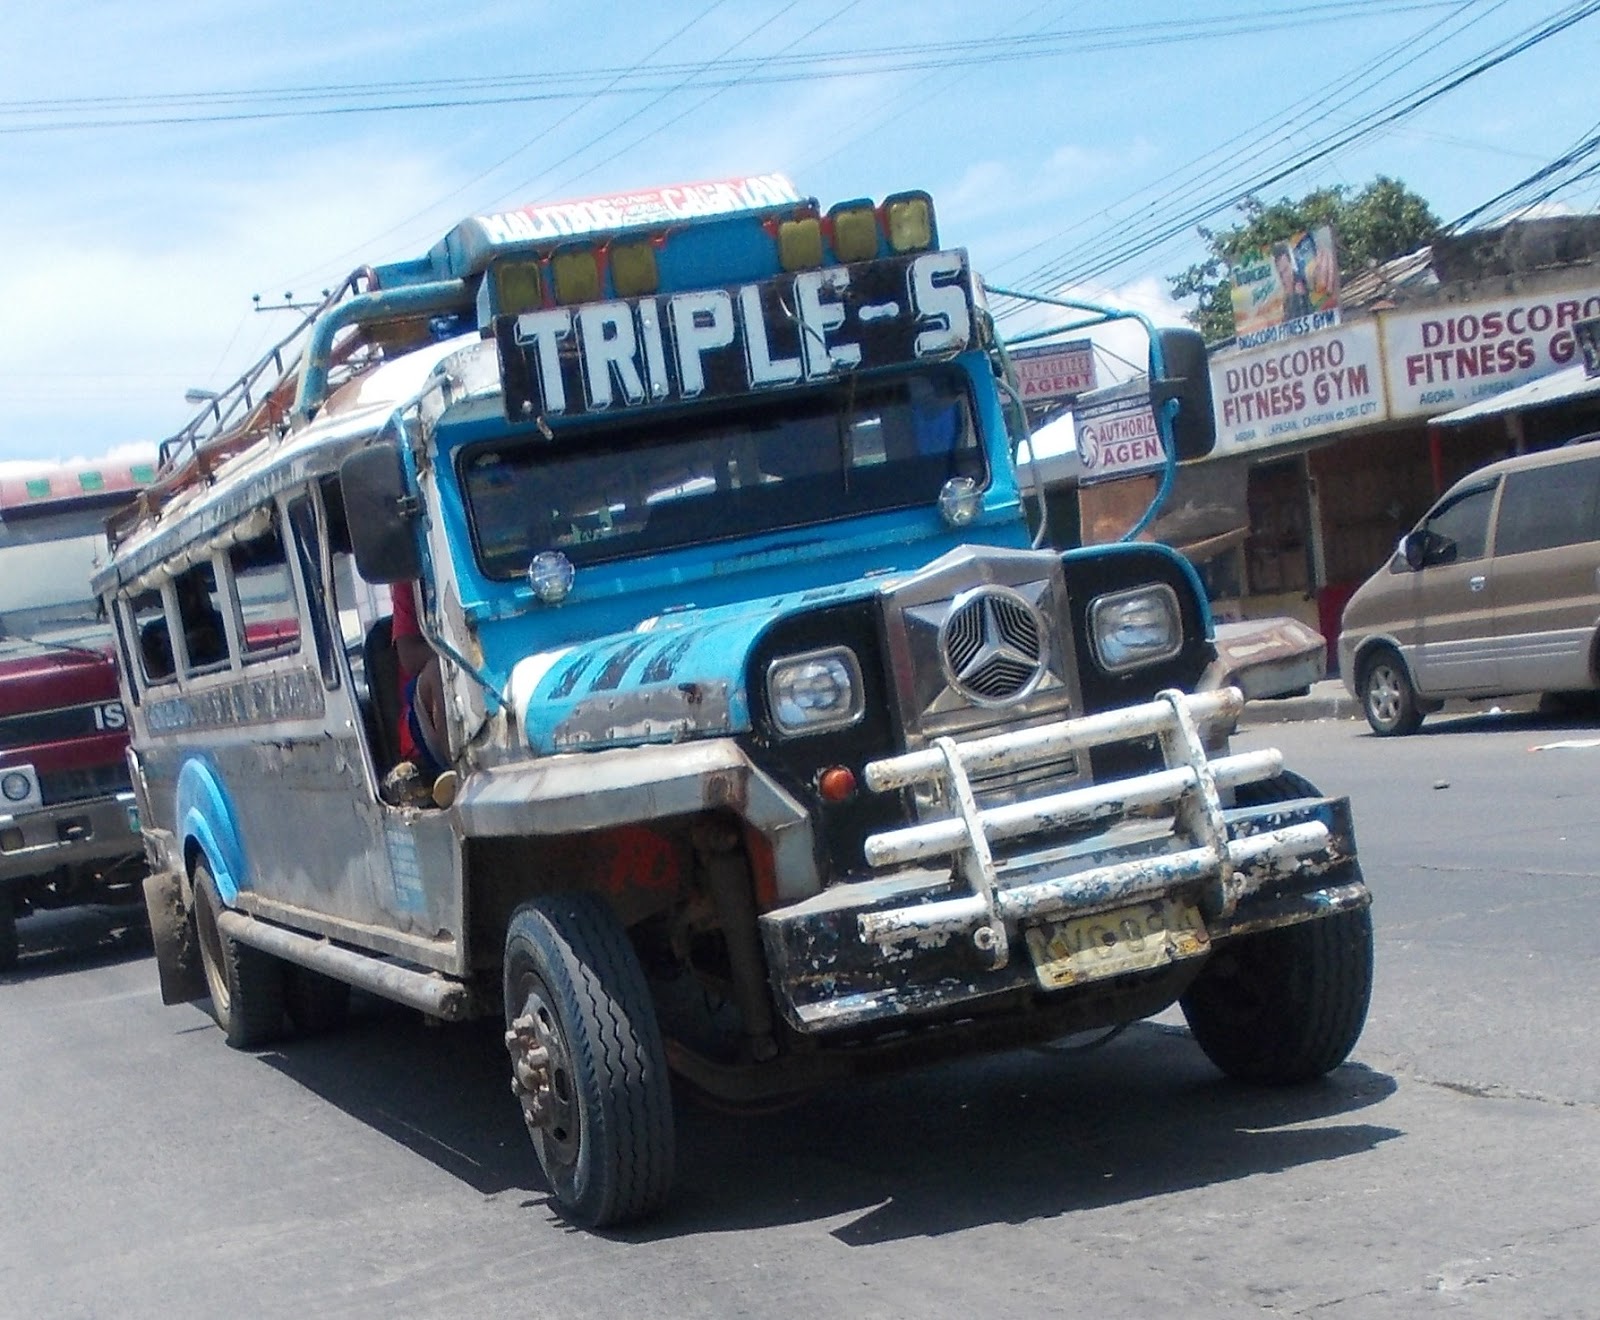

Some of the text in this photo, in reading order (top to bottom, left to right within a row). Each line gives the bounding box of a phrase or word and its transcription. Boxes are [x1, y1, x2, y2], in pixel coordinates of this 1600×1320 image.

[660, 173, 798, 217] CAGAYAN
[514, 251, 970, 413] TRIPLE-S
[1313, 309, 1336, 331] GYM
[1226, 339, 1344, 394] DIOSCORO
[1406, 330, 1577, 386] FITNESS G
[1025, 373, 1091, 395] AGENT
[1222, 364, 1370, 427] FITNESS GYM
[1103, 438, 1158, 466] AGEN
[93, 703, 126, 730] IS
